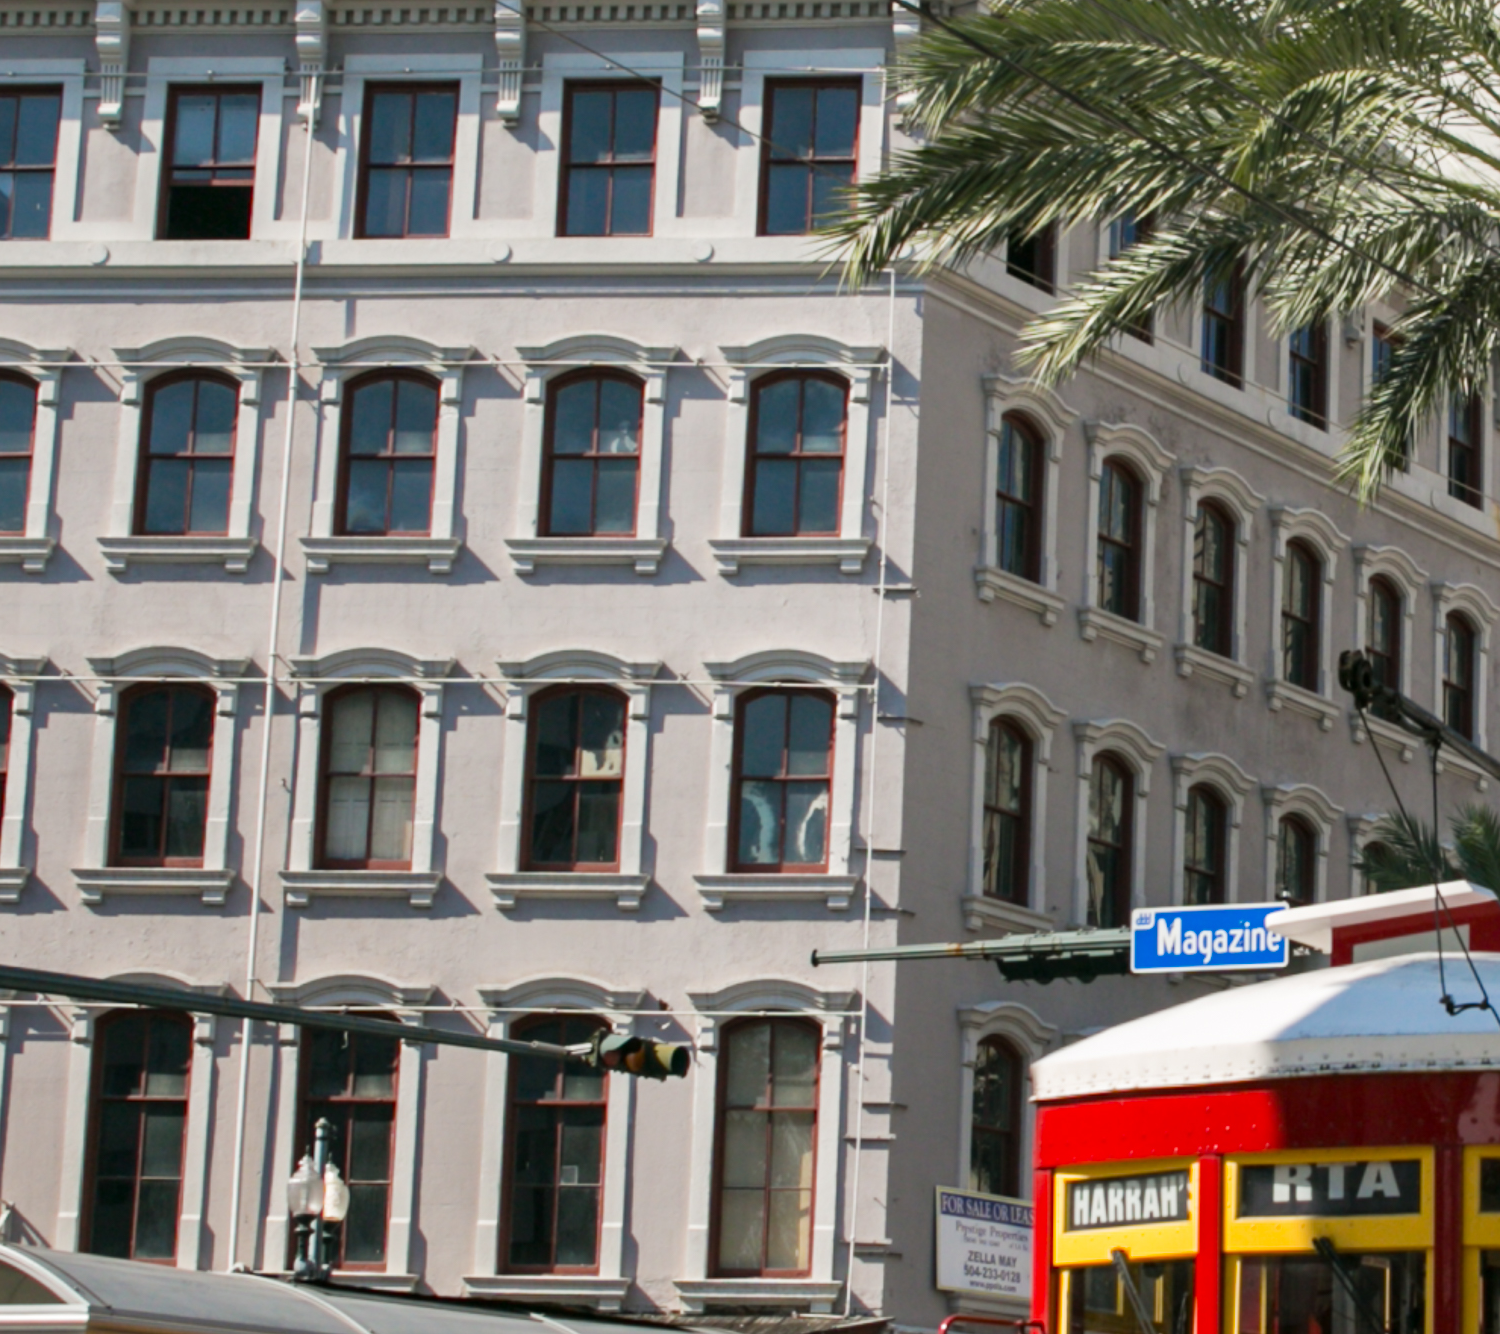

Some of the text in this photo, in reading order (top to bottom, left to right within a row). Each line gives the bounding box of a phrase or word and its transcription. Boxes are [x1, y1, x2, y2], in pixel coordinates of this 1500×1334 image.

[1157, 917, 1282, 964] Magazine
[1273, 1161, 1400, 1203] RTA
[942, 1195, 965, 1215] FOR
[966, 1199, 991, 1219] SALE
[993, 1204, 1009, 1222] OR
